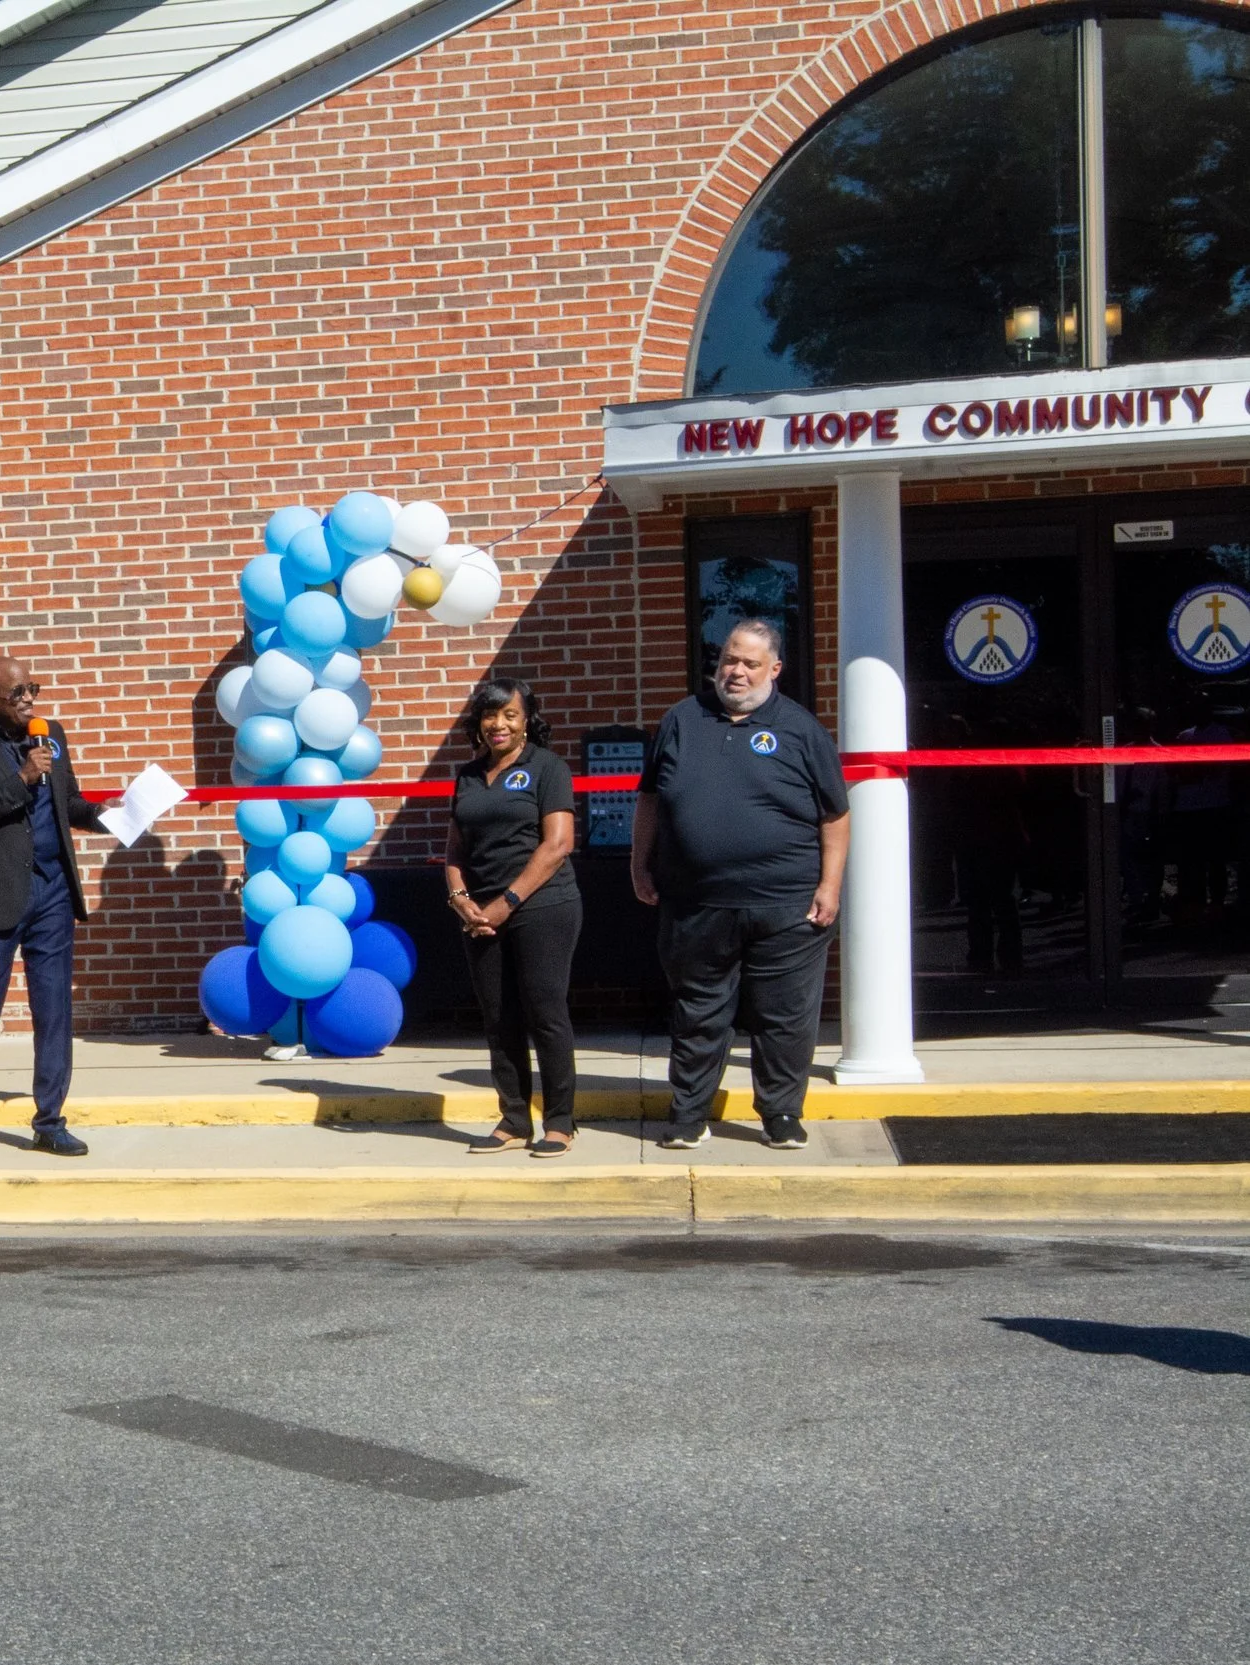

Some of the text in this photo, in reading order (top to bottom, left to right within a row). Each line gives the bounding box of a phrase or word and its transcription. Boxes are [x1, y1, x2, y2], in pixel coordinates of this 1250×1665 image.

[684, 418, 765, 453] NEW
[789, 408, 899, 446] HOPE
[925, 386, 1213, 438] COMMUNITY
